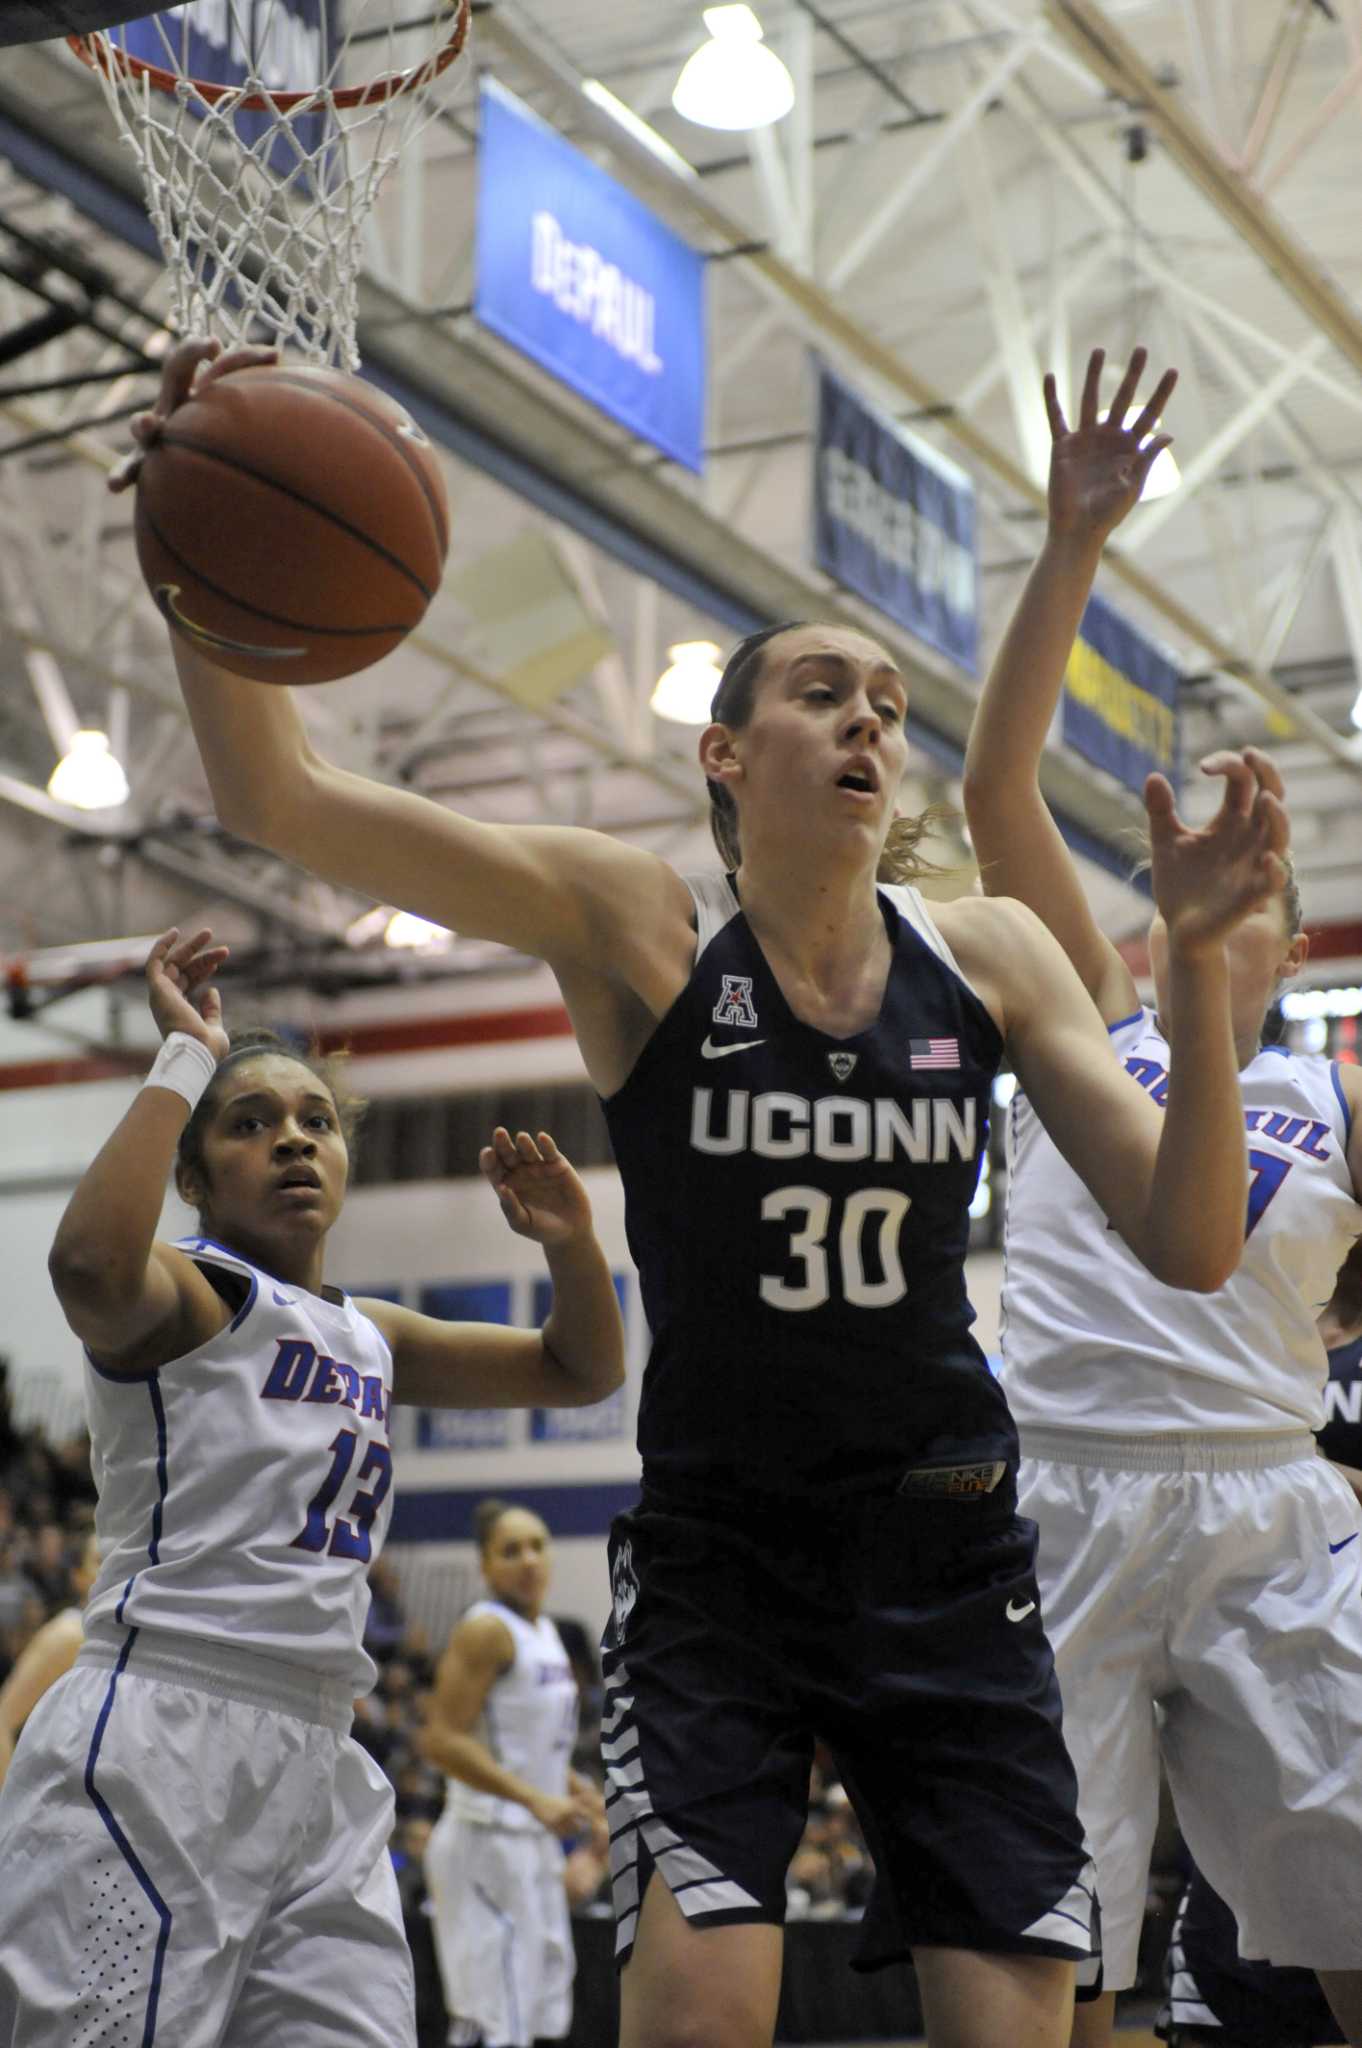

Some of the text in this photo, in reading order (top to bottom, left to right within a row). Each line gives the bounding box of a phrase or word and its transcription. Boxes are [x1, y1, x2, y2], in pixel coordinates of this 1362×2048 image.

[689, 1086, 977, 1164] UCONN
[759, 1185, 911, 1312] 30
[289, 1428, 393, 1564] 13
[951, 1466, 993, 1482] NIKE
